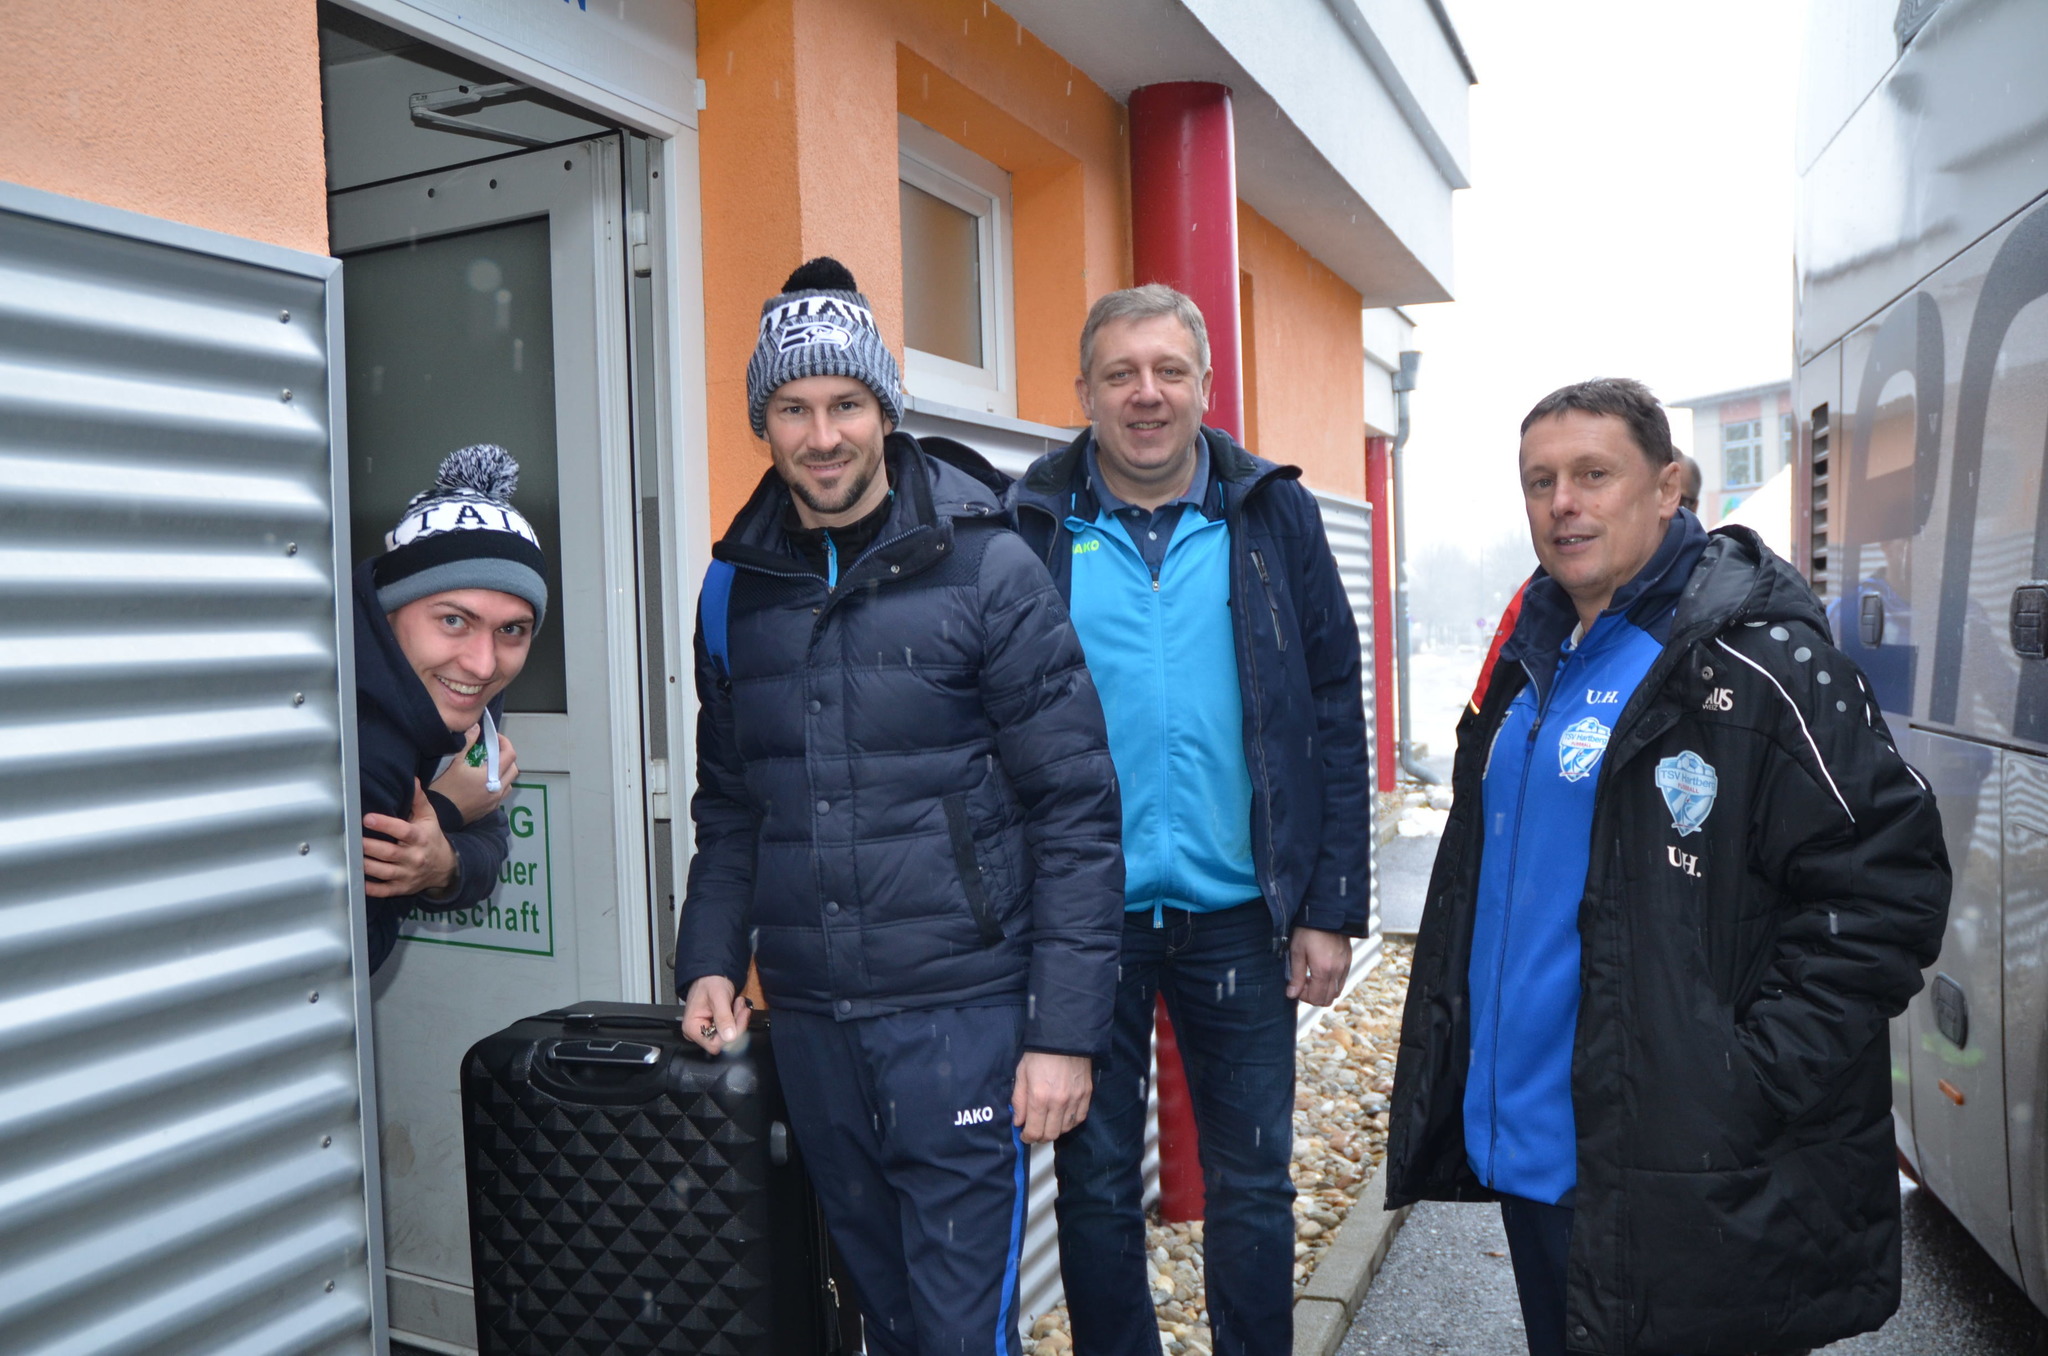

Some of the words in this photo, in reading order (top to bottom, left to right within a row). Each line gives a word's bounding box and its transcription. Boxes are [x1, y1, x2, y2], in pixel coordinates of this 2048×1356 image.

[1586, 688, 1619, 705] U.H.
[1704, 687, 1734, 711] AUS
[1577, 734, 1608, 746] Hartberg
[1660, 768, 1680, 780] TSV
[1681, 772, 1716, 792] Hartberg
[954, 1105, 994, 1126] JAKO
